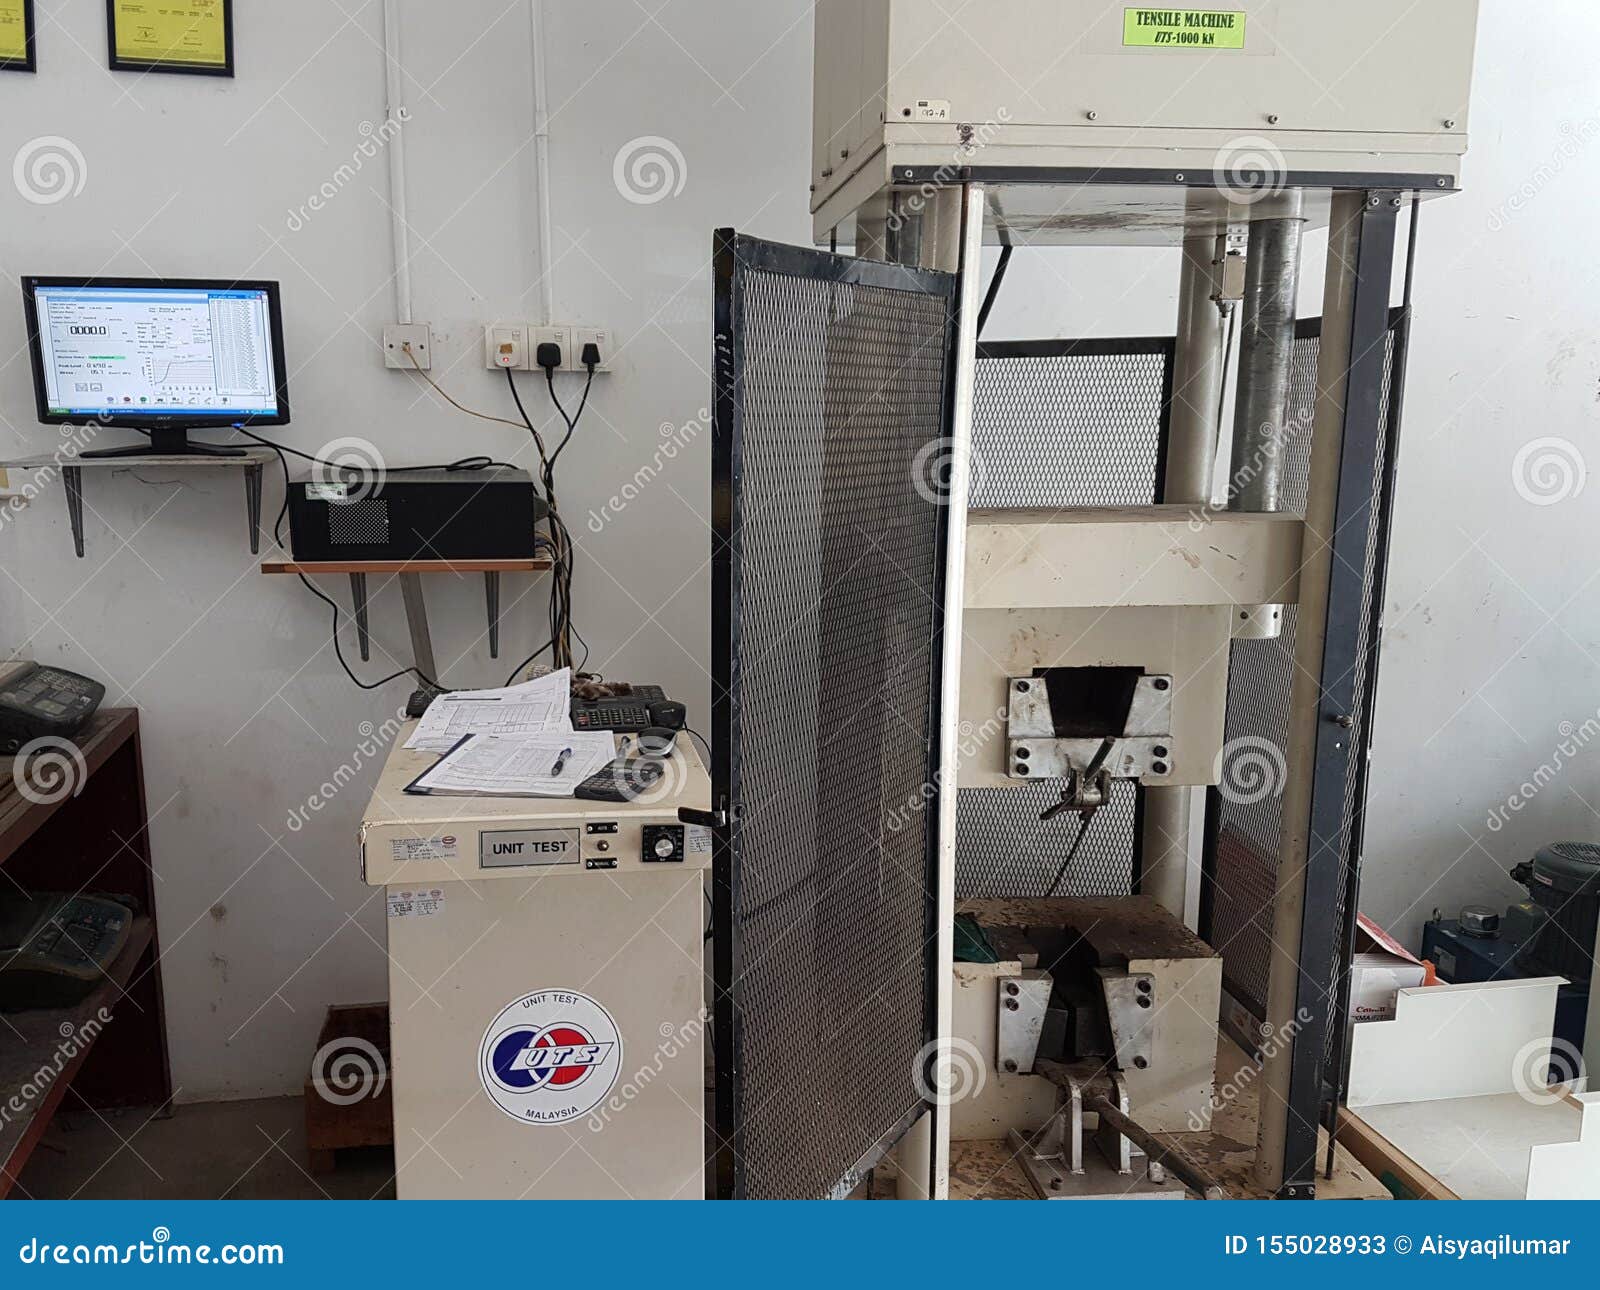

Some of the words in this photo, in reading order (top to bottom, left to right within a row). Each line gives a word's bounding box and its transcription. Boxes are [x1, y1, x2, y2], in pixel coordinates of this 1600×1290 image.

[1136, 11, 1181, 27] TENSILE
[1184, 12, 1235, 28] MACHINE
[493, 842, 524, 855] UNIT
[532, 840, 568, 853] TEST
[522, 995, 547, 1009] UNIT
[552, 994, 579, 1005] TEST
[525, 1045, 600, 1067] UTS
[525, 1105, 579, 1120] MALAYSIA
